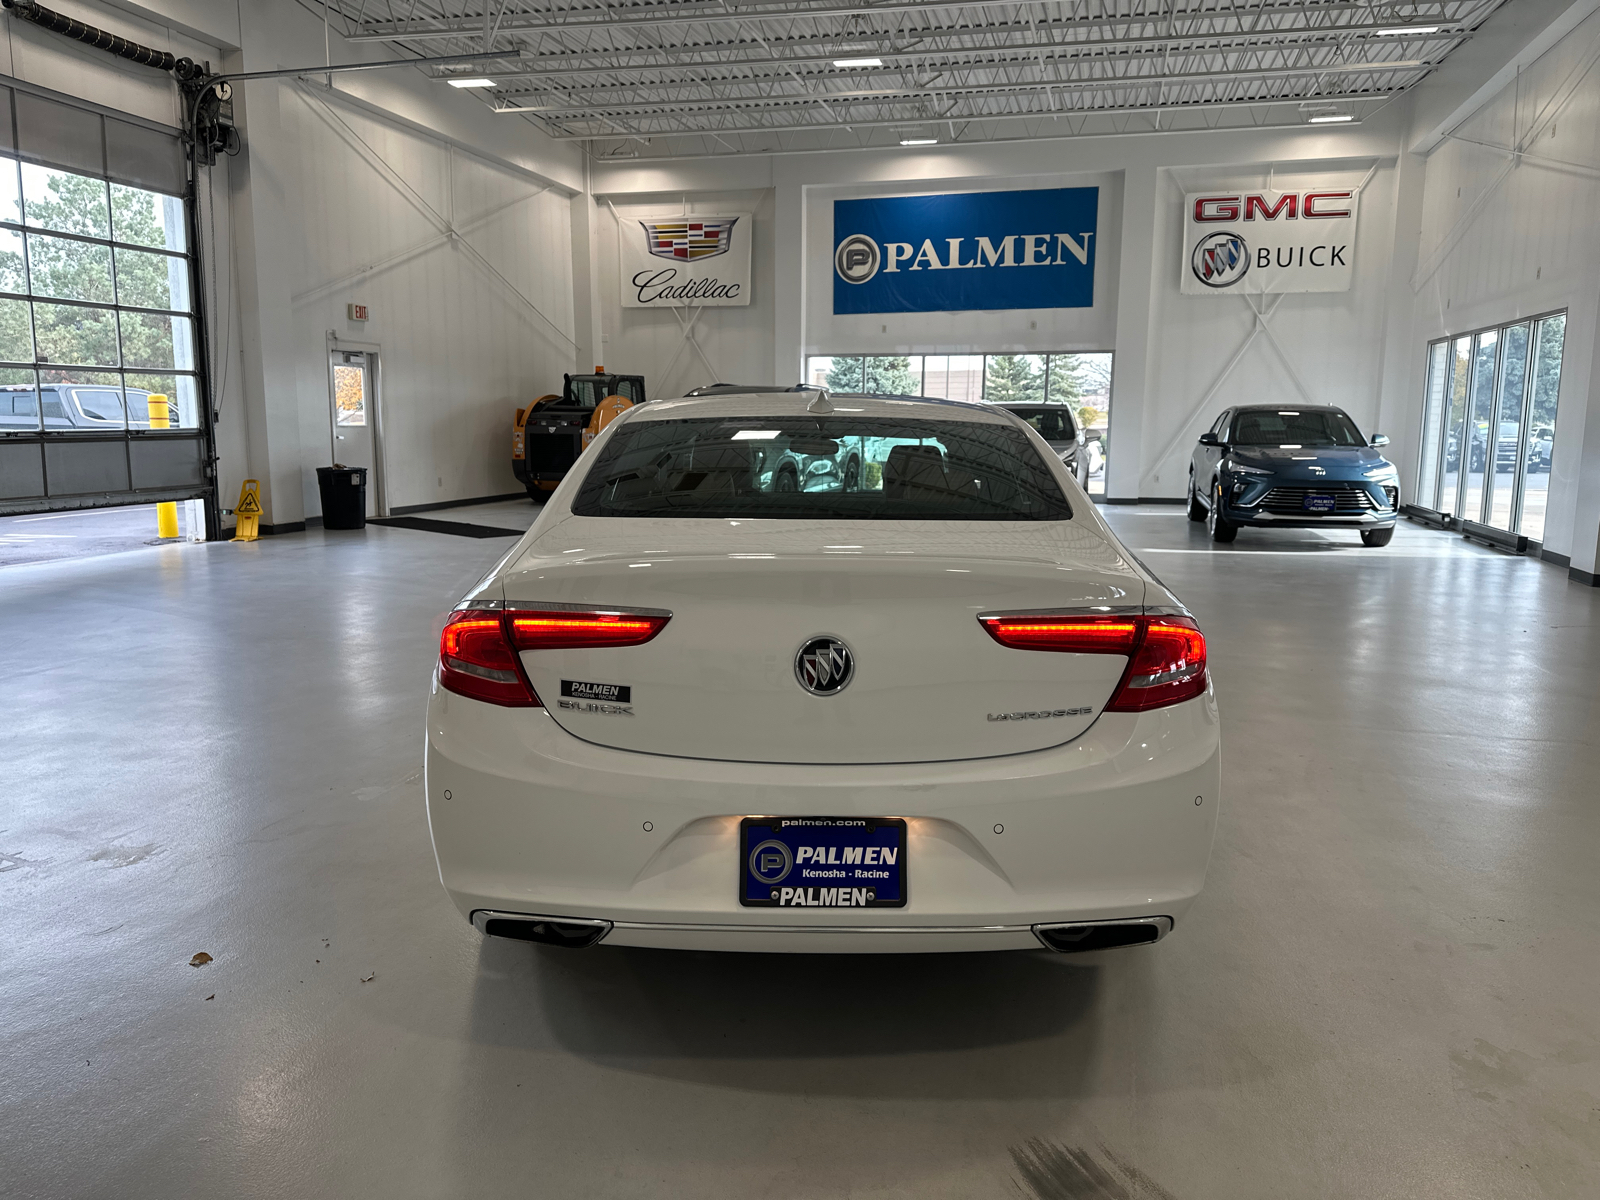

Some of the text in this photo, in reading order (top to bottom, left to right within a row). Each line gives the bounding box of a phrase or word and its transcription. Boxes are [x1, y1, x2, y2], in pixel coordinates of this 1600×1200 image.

[1193, 191, 1352, 223] GMC
[882, 232, 1094, 273] PALMEN
[1257, 245, 1347, 268] BUICK
[632, 268, 740, 303] Cadillac
[355, 305, 366, 320] EXIT
[571, 682, 619, 696] PALMEN
[571, 691, 595, 699] KENOSHA
[557, 700, 634, 716] BUICK
[781, 819, 866, 827] palmen.com
[796, 846, 898, 865] PALMEN
[802, 869, 846, 878] Kenosha
[855, 869, 890, 878] Racine
[779, 887, 867, 906] PALMEN
